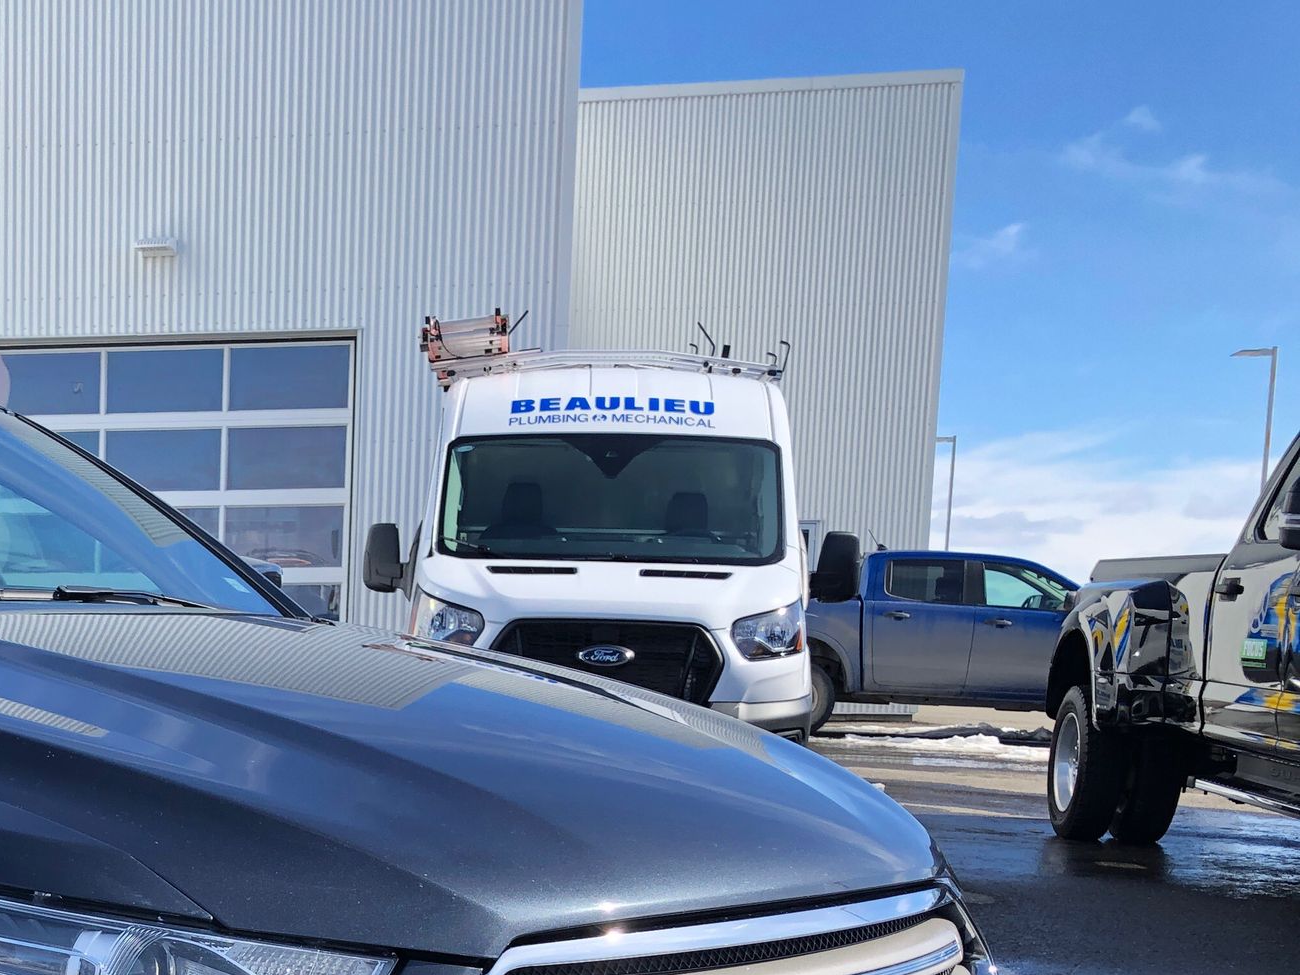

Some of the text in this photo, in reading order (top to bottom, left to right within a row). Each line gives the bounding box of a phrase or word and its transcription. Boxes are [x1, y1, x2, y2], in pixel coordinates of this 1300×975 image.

[510, 396, 715, 416] BEAULIEU
[508, 413, 716, 429] PLUMBING MECHANICAL
[590, 649, 620, 662] Ford
